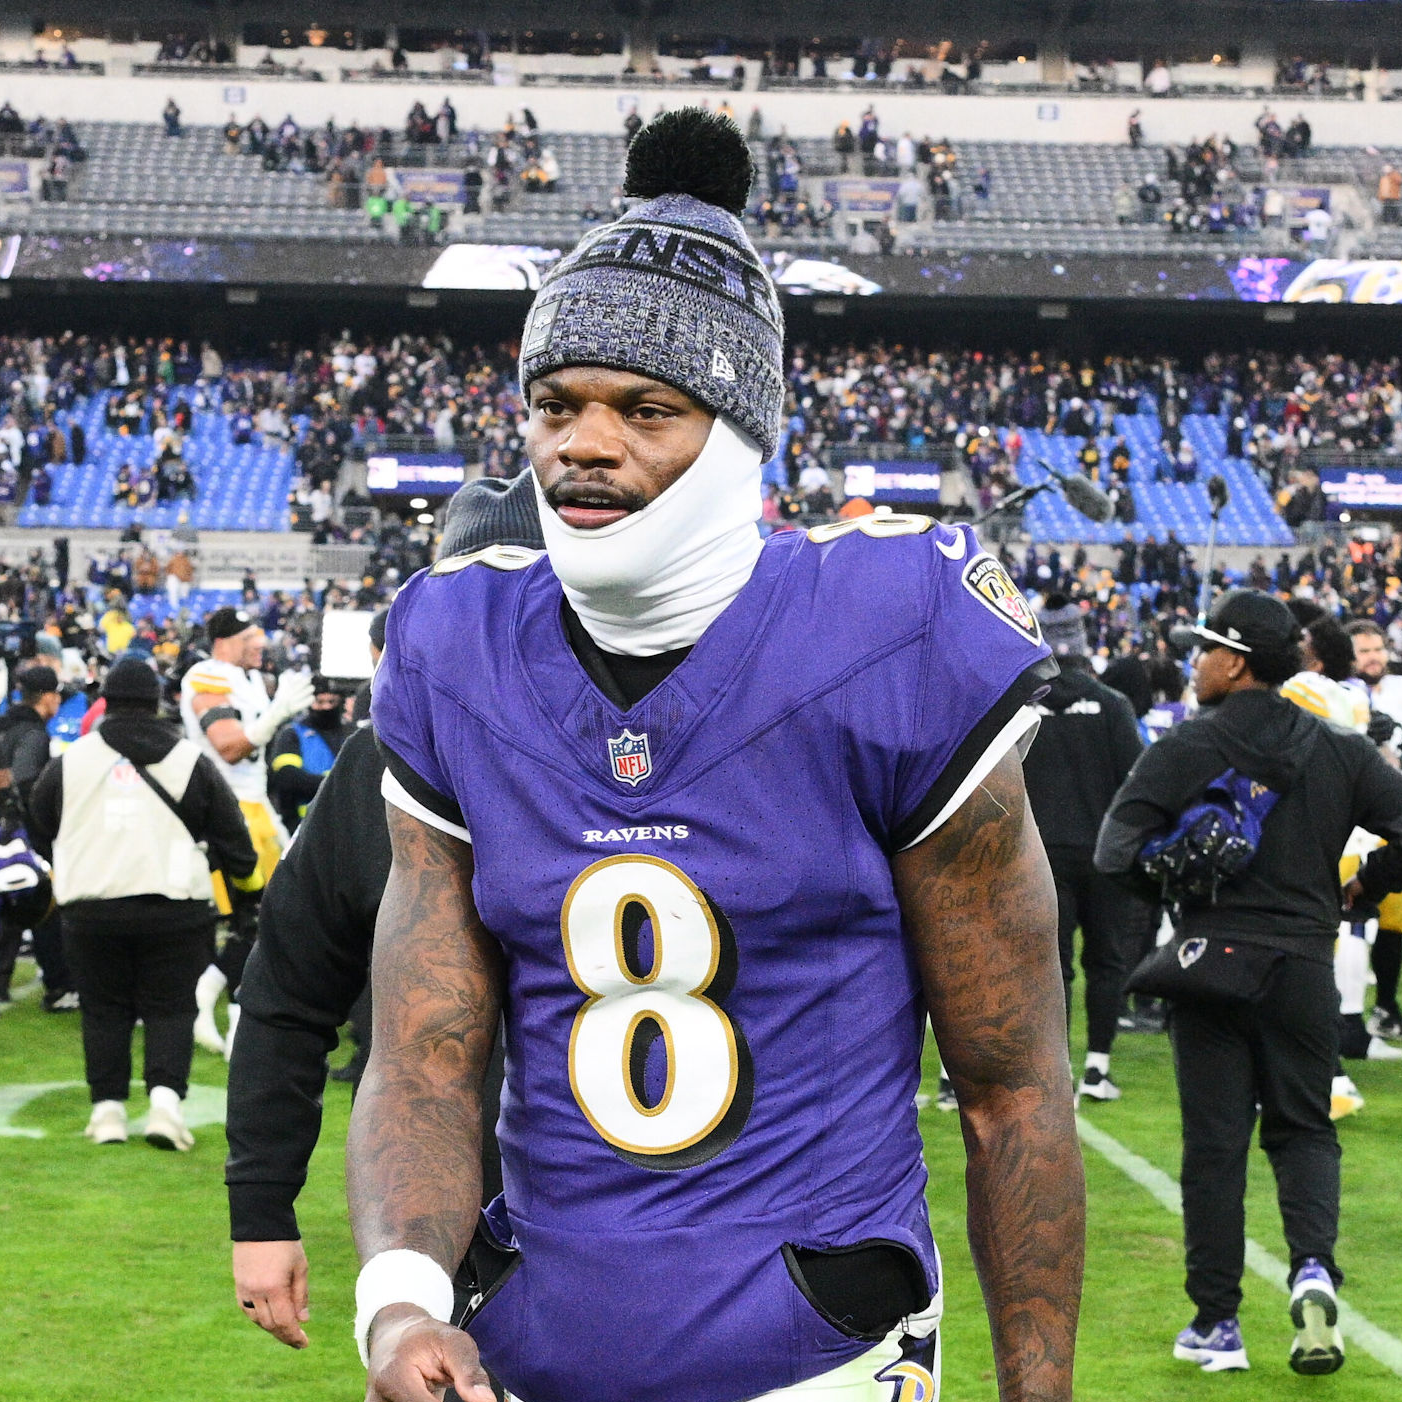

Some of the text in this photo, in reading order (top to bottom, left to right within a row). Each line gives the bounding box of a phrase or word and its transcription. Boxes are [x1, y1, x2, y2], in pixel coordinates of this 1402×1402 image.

[616, 755, 646, 777] NFL
[582, 825, 690, 843] RAVENS
[559, 853, 755, 1173] 8
